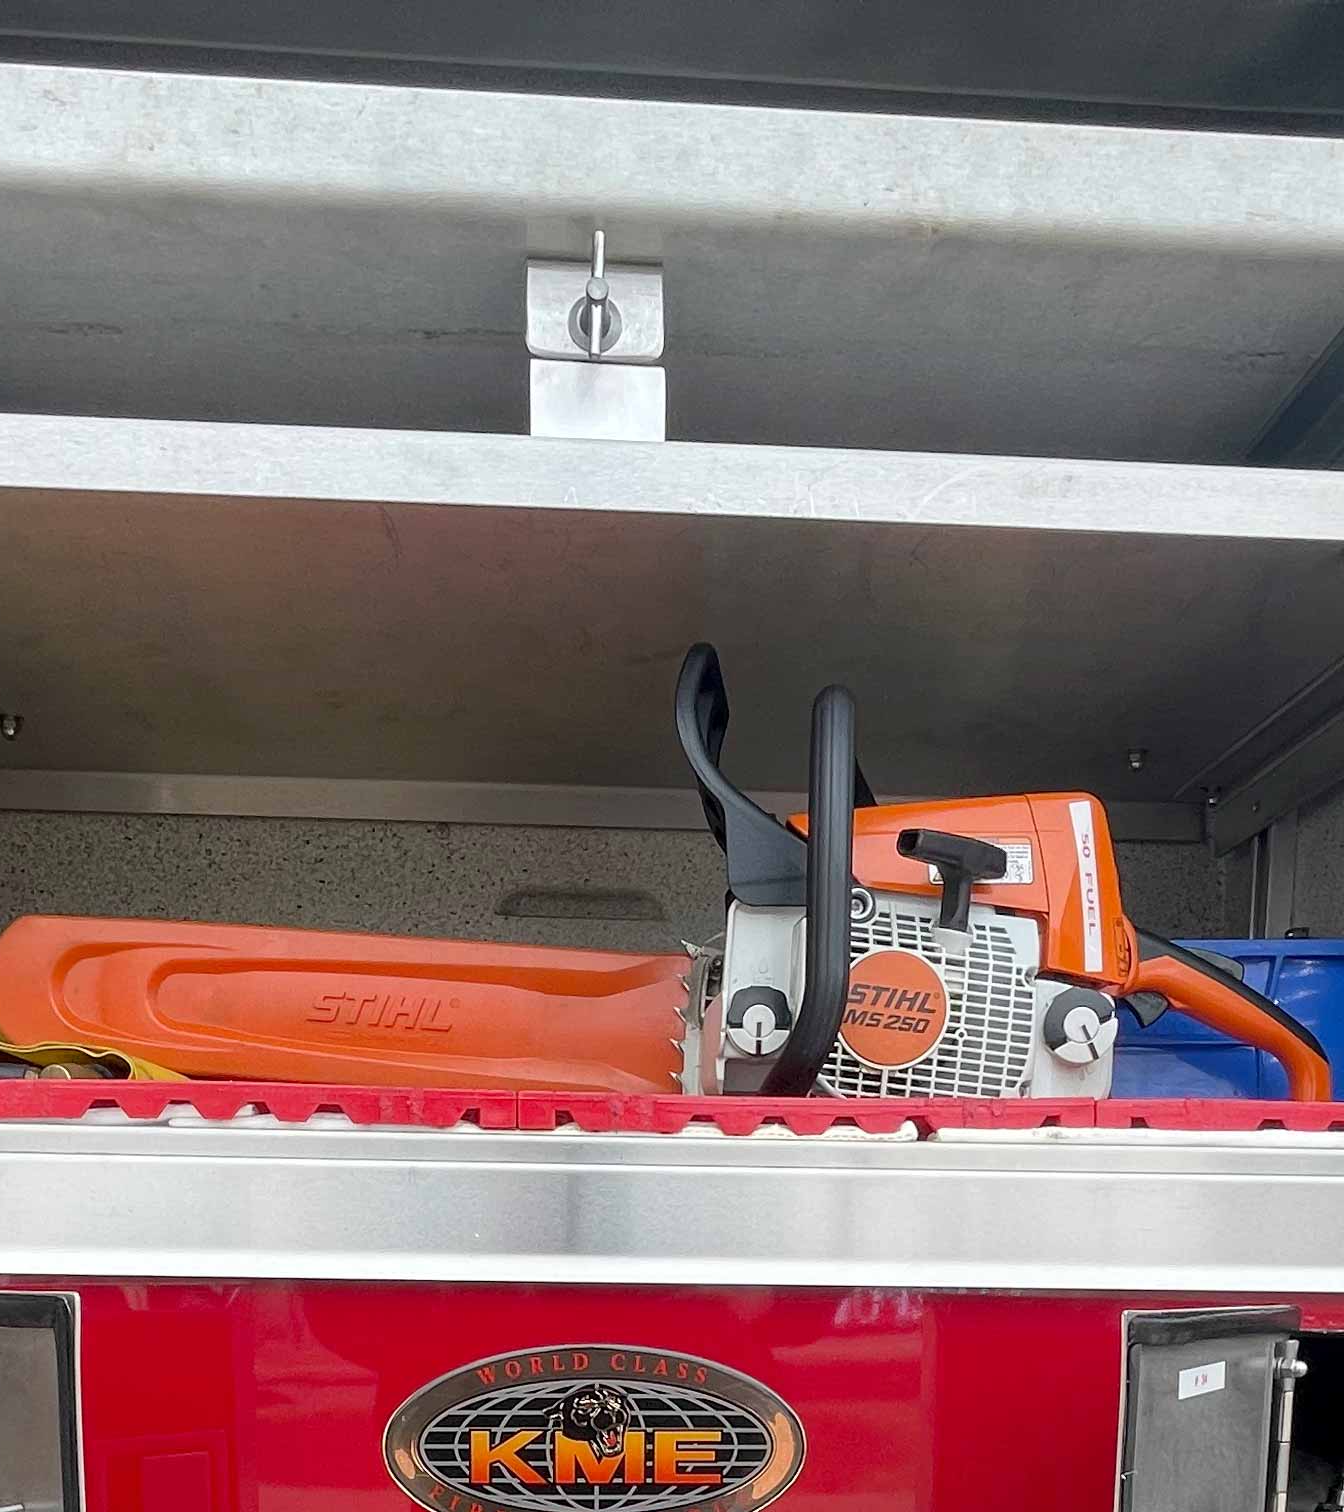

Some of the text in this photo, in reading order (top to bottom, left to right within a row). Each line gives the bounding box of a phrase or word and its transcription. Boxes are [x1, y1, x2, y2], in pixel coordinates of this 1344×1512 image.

[1085, 872, 1097, 937] FUEL
[306, 991, 454, 1033] STIHL
[846, 983, 937, 1014] STIHL
[842, 1008, 931, 1034] MS 250
[475, 1352, 710, 1386] WORLD CLASS
[467, 1429, 723, 1485] KME
